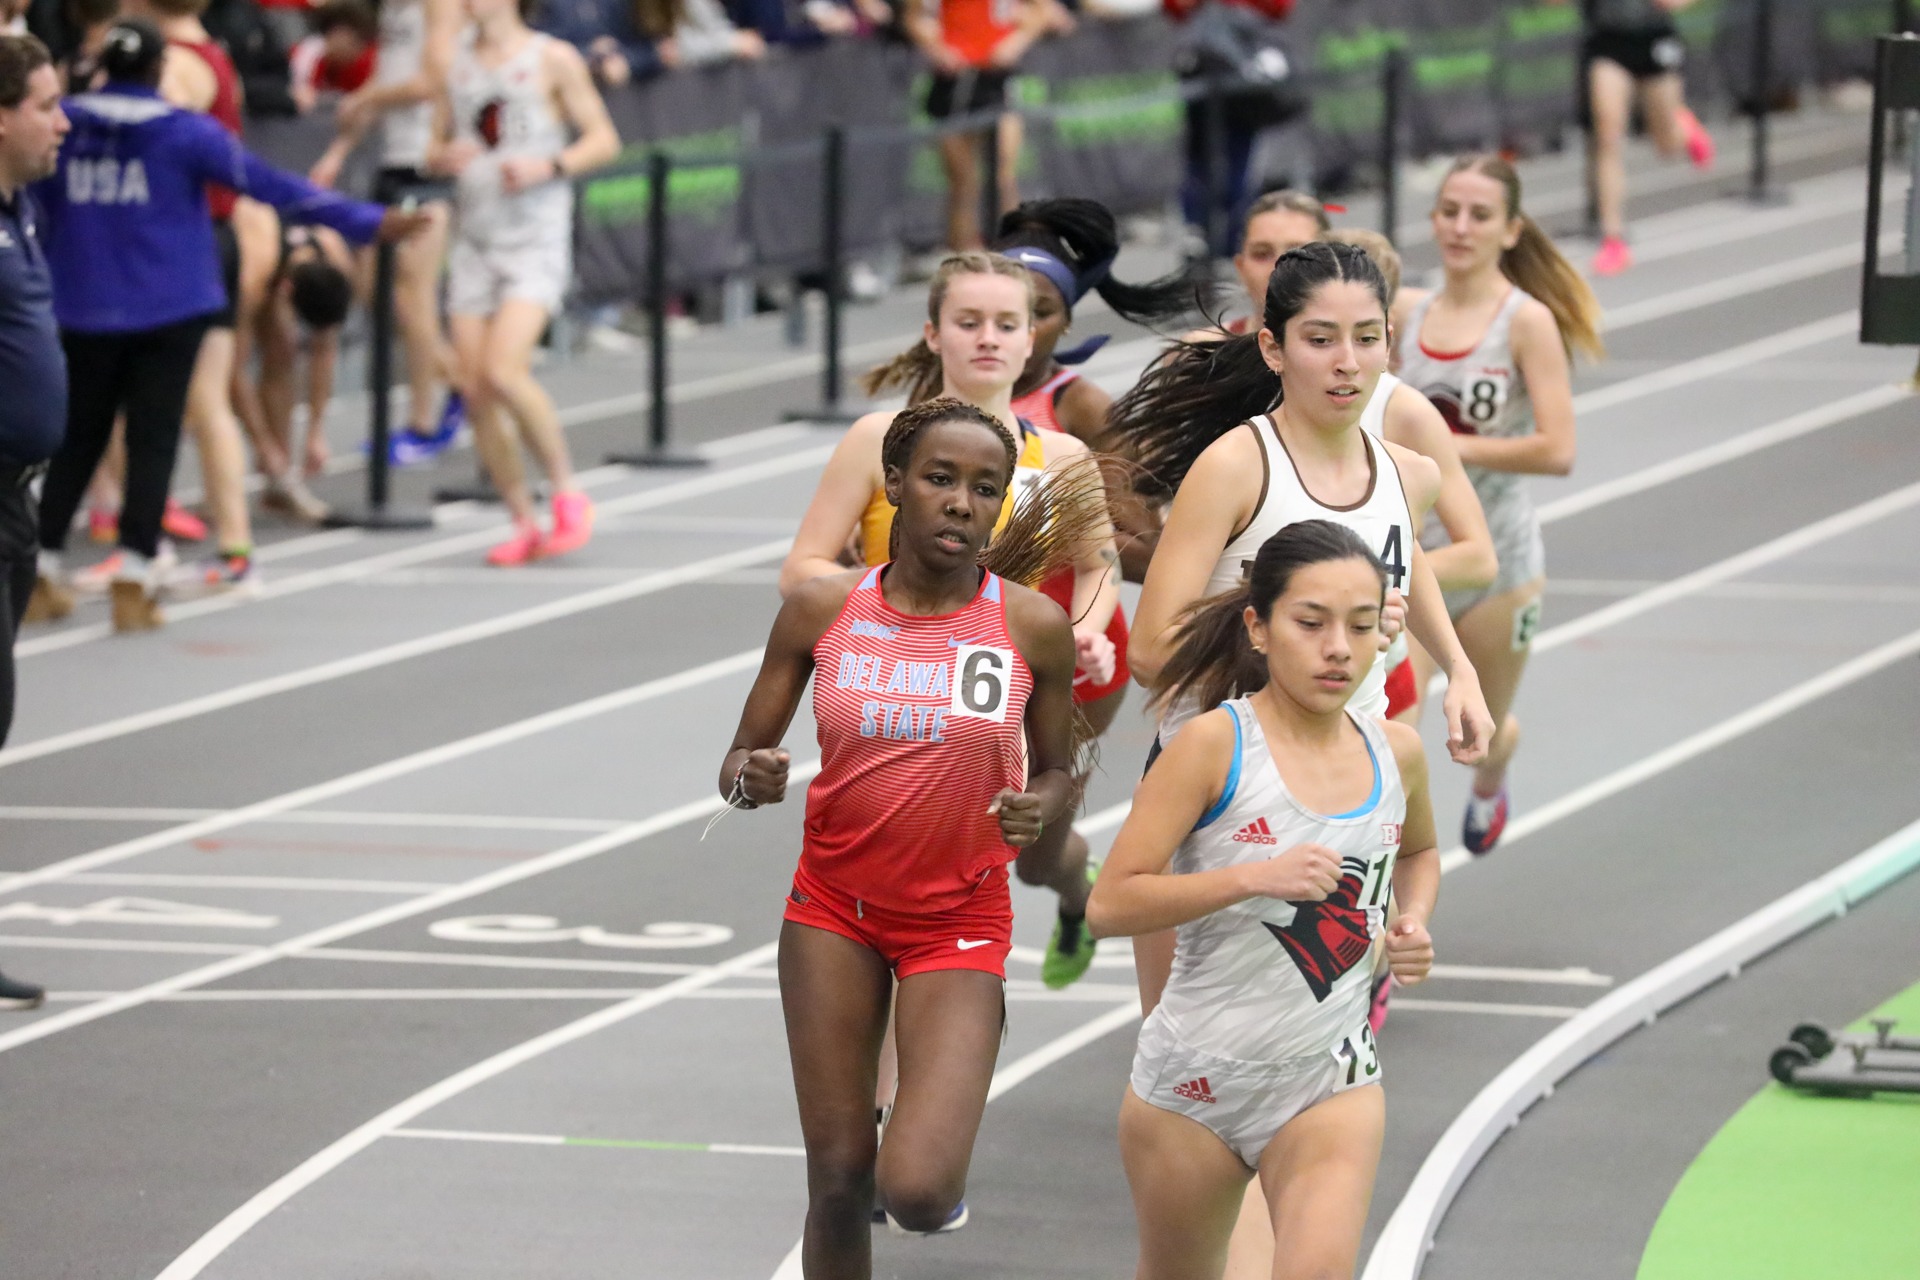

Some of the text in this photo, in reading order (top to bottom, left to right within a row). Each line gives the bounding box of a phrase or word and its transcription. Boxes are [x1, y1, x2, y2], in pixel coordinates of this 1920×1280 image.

[67, 158, 149, 205] USA
[1469, 380, 1496, 421] 8
[1378, 524, 1406, 589] 4
[849, 619, 901, 640] MEAC
[837, 651, 950, 697] DELAWA
[961, 650, 1004, 714] 6
[860, 701, 950, 743] STATE
[1232, 833, 1277, 845] adidas
[1369, 853, 1397, 906] 1
[1338, 1023, 1378, 1086] 13
[1173, 1086, 1217, 1104] adidas
